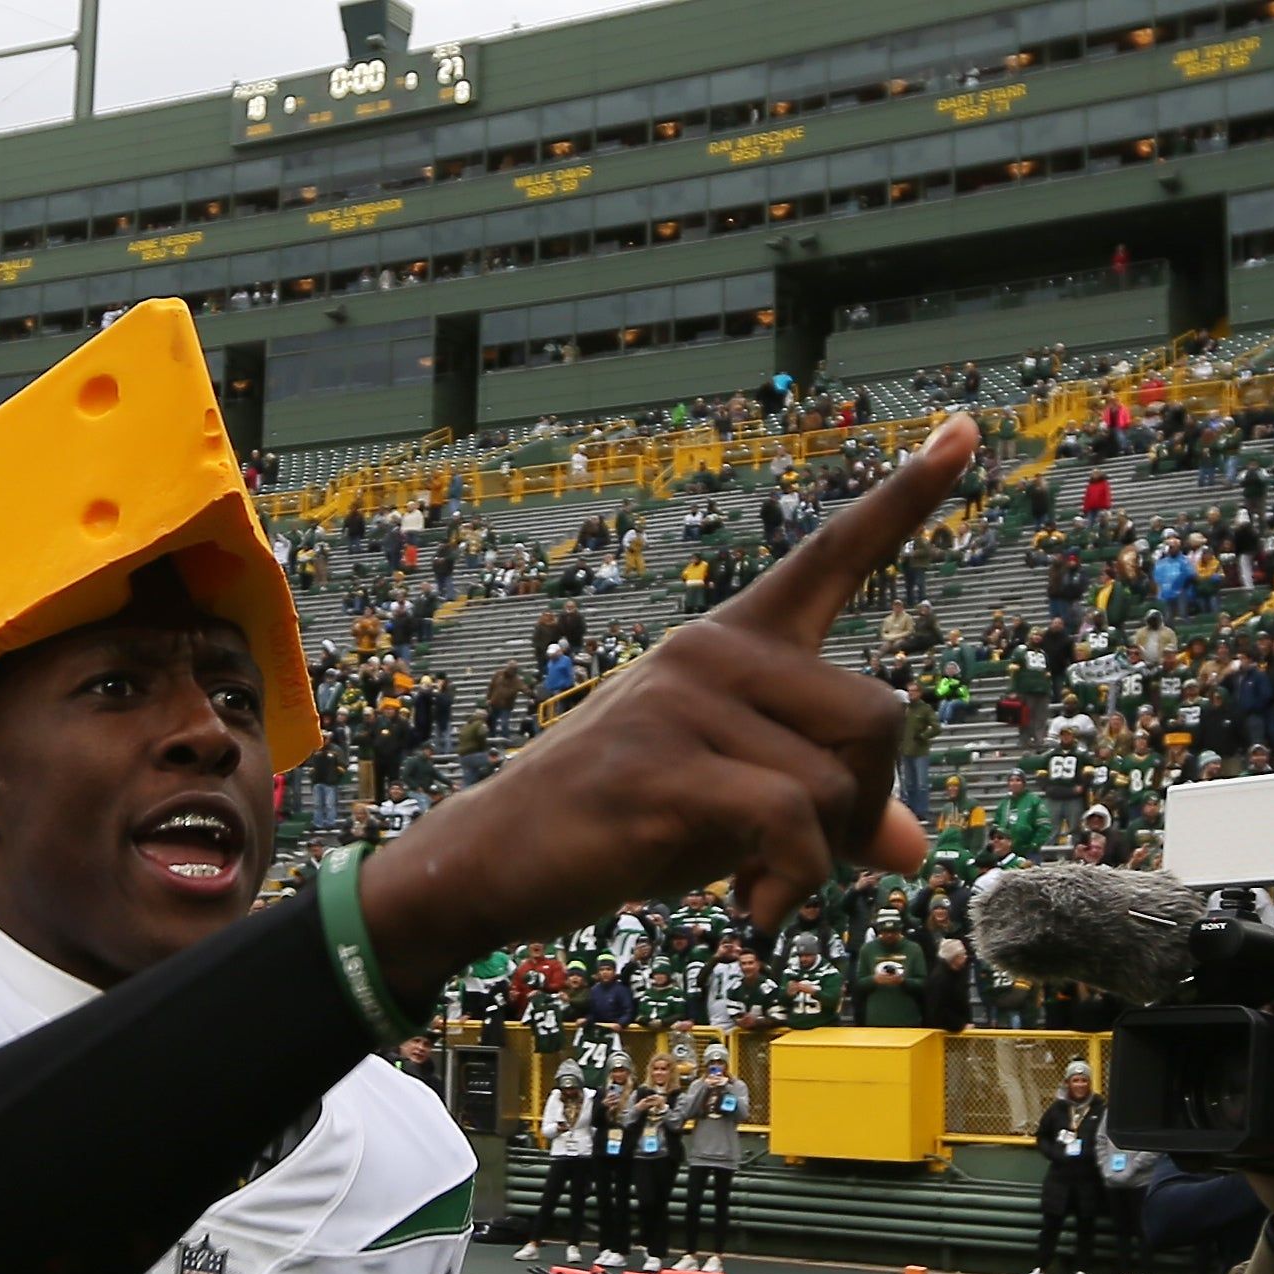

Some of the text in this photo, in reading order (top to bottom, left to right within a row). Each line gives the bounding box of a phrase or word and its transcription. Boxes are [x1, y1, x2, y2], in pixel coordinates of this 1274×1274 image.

[329, 59, 387, 100] 0:00
[937, 83, 1026, 111] BART STARR
[1049, 755, 1078, 779] 69
[1200, 922, 1227, 931] SONY
[578, 1041, 608, 1069] 74
